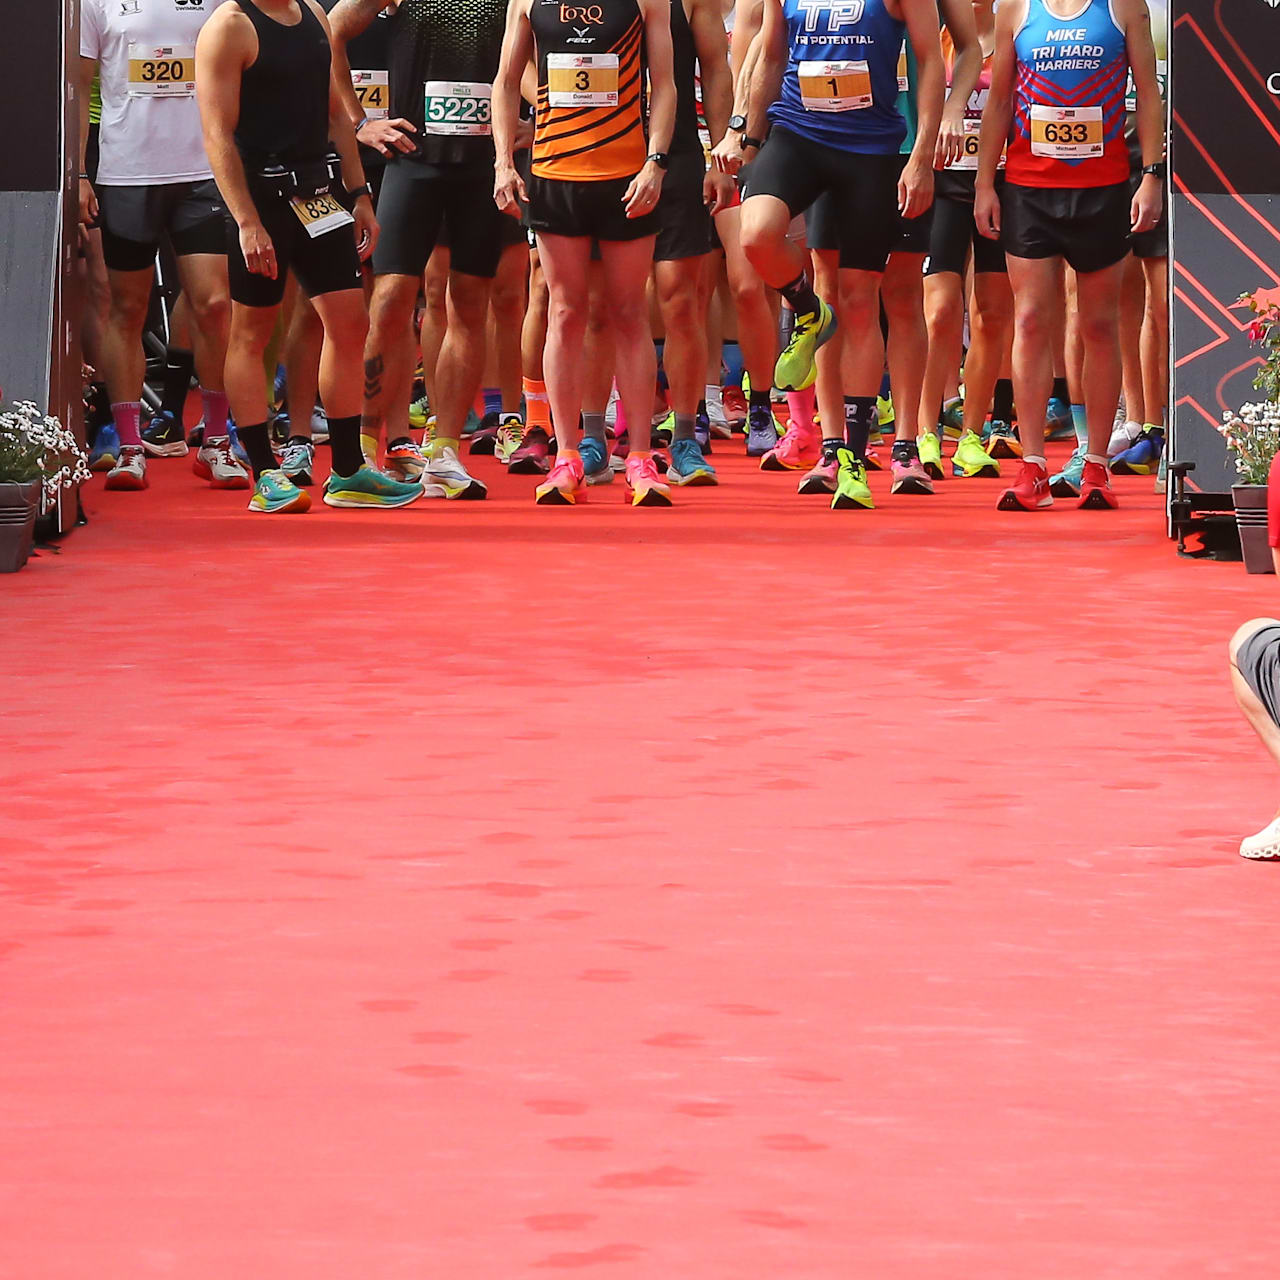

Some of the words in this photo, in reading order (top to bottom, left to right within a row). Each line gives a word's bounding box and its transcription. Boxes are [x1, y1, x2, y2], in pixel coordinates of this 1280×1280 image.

[810, 35, 874, 46] POTENTIAL
[1045, 28, 1087, 43] MIKE
[1032, 47, 1055, 60] TRI
[1059, 45, 1104, 58] HARD
[142, 61, 184, 82] 320
[1035, 59, 1101, 72] HARRIERS
[575, 71, 590, 91] 3
[827, 78, 838, 97] 1
[428, 97, 491, 122] 5223
[1044, 123, 1088, 143] 633
